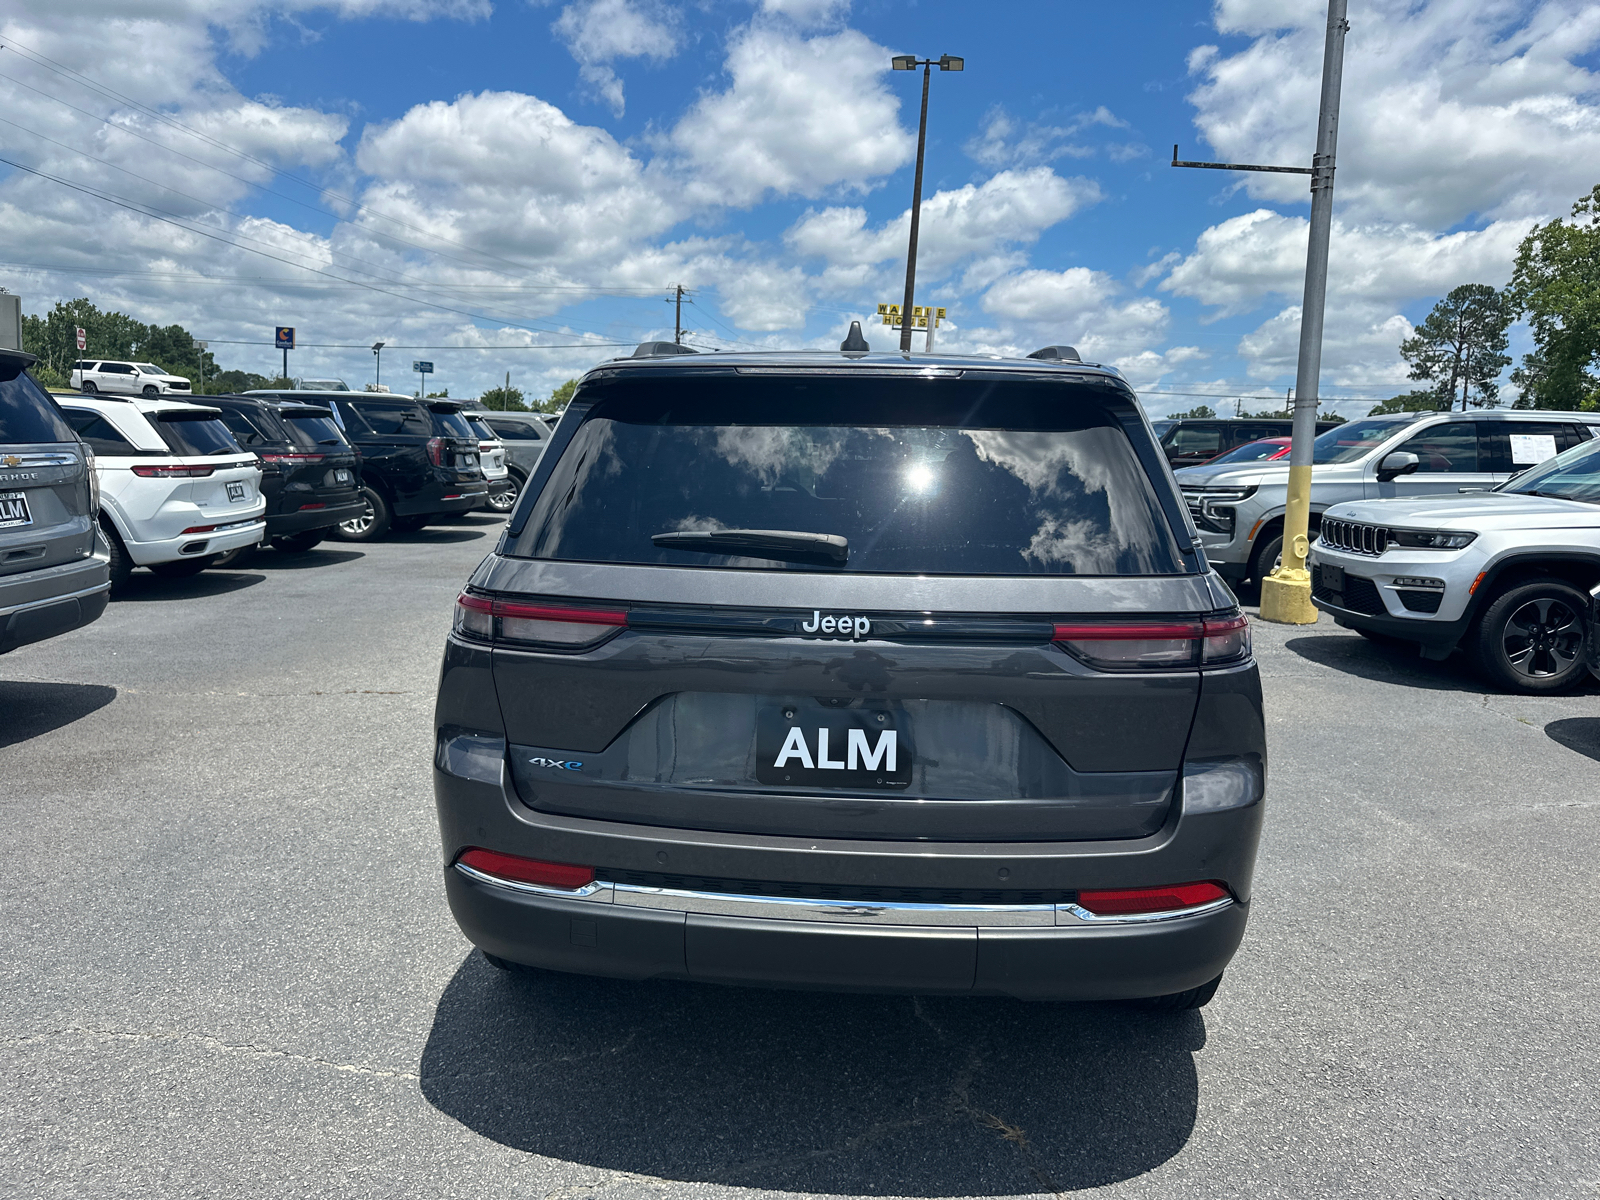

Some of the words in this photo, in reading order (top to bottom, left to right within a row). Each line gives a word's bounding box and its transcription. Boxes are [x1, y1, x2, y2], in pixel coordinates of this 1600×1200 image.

[879, 304, 945, 317] WAFLE
[884, 315, 938, 327] HOS
[337, 472, 348, 481] ALM
[802, 610, 871, 639] Jeep
[773, 726, 898, 772] ALM
